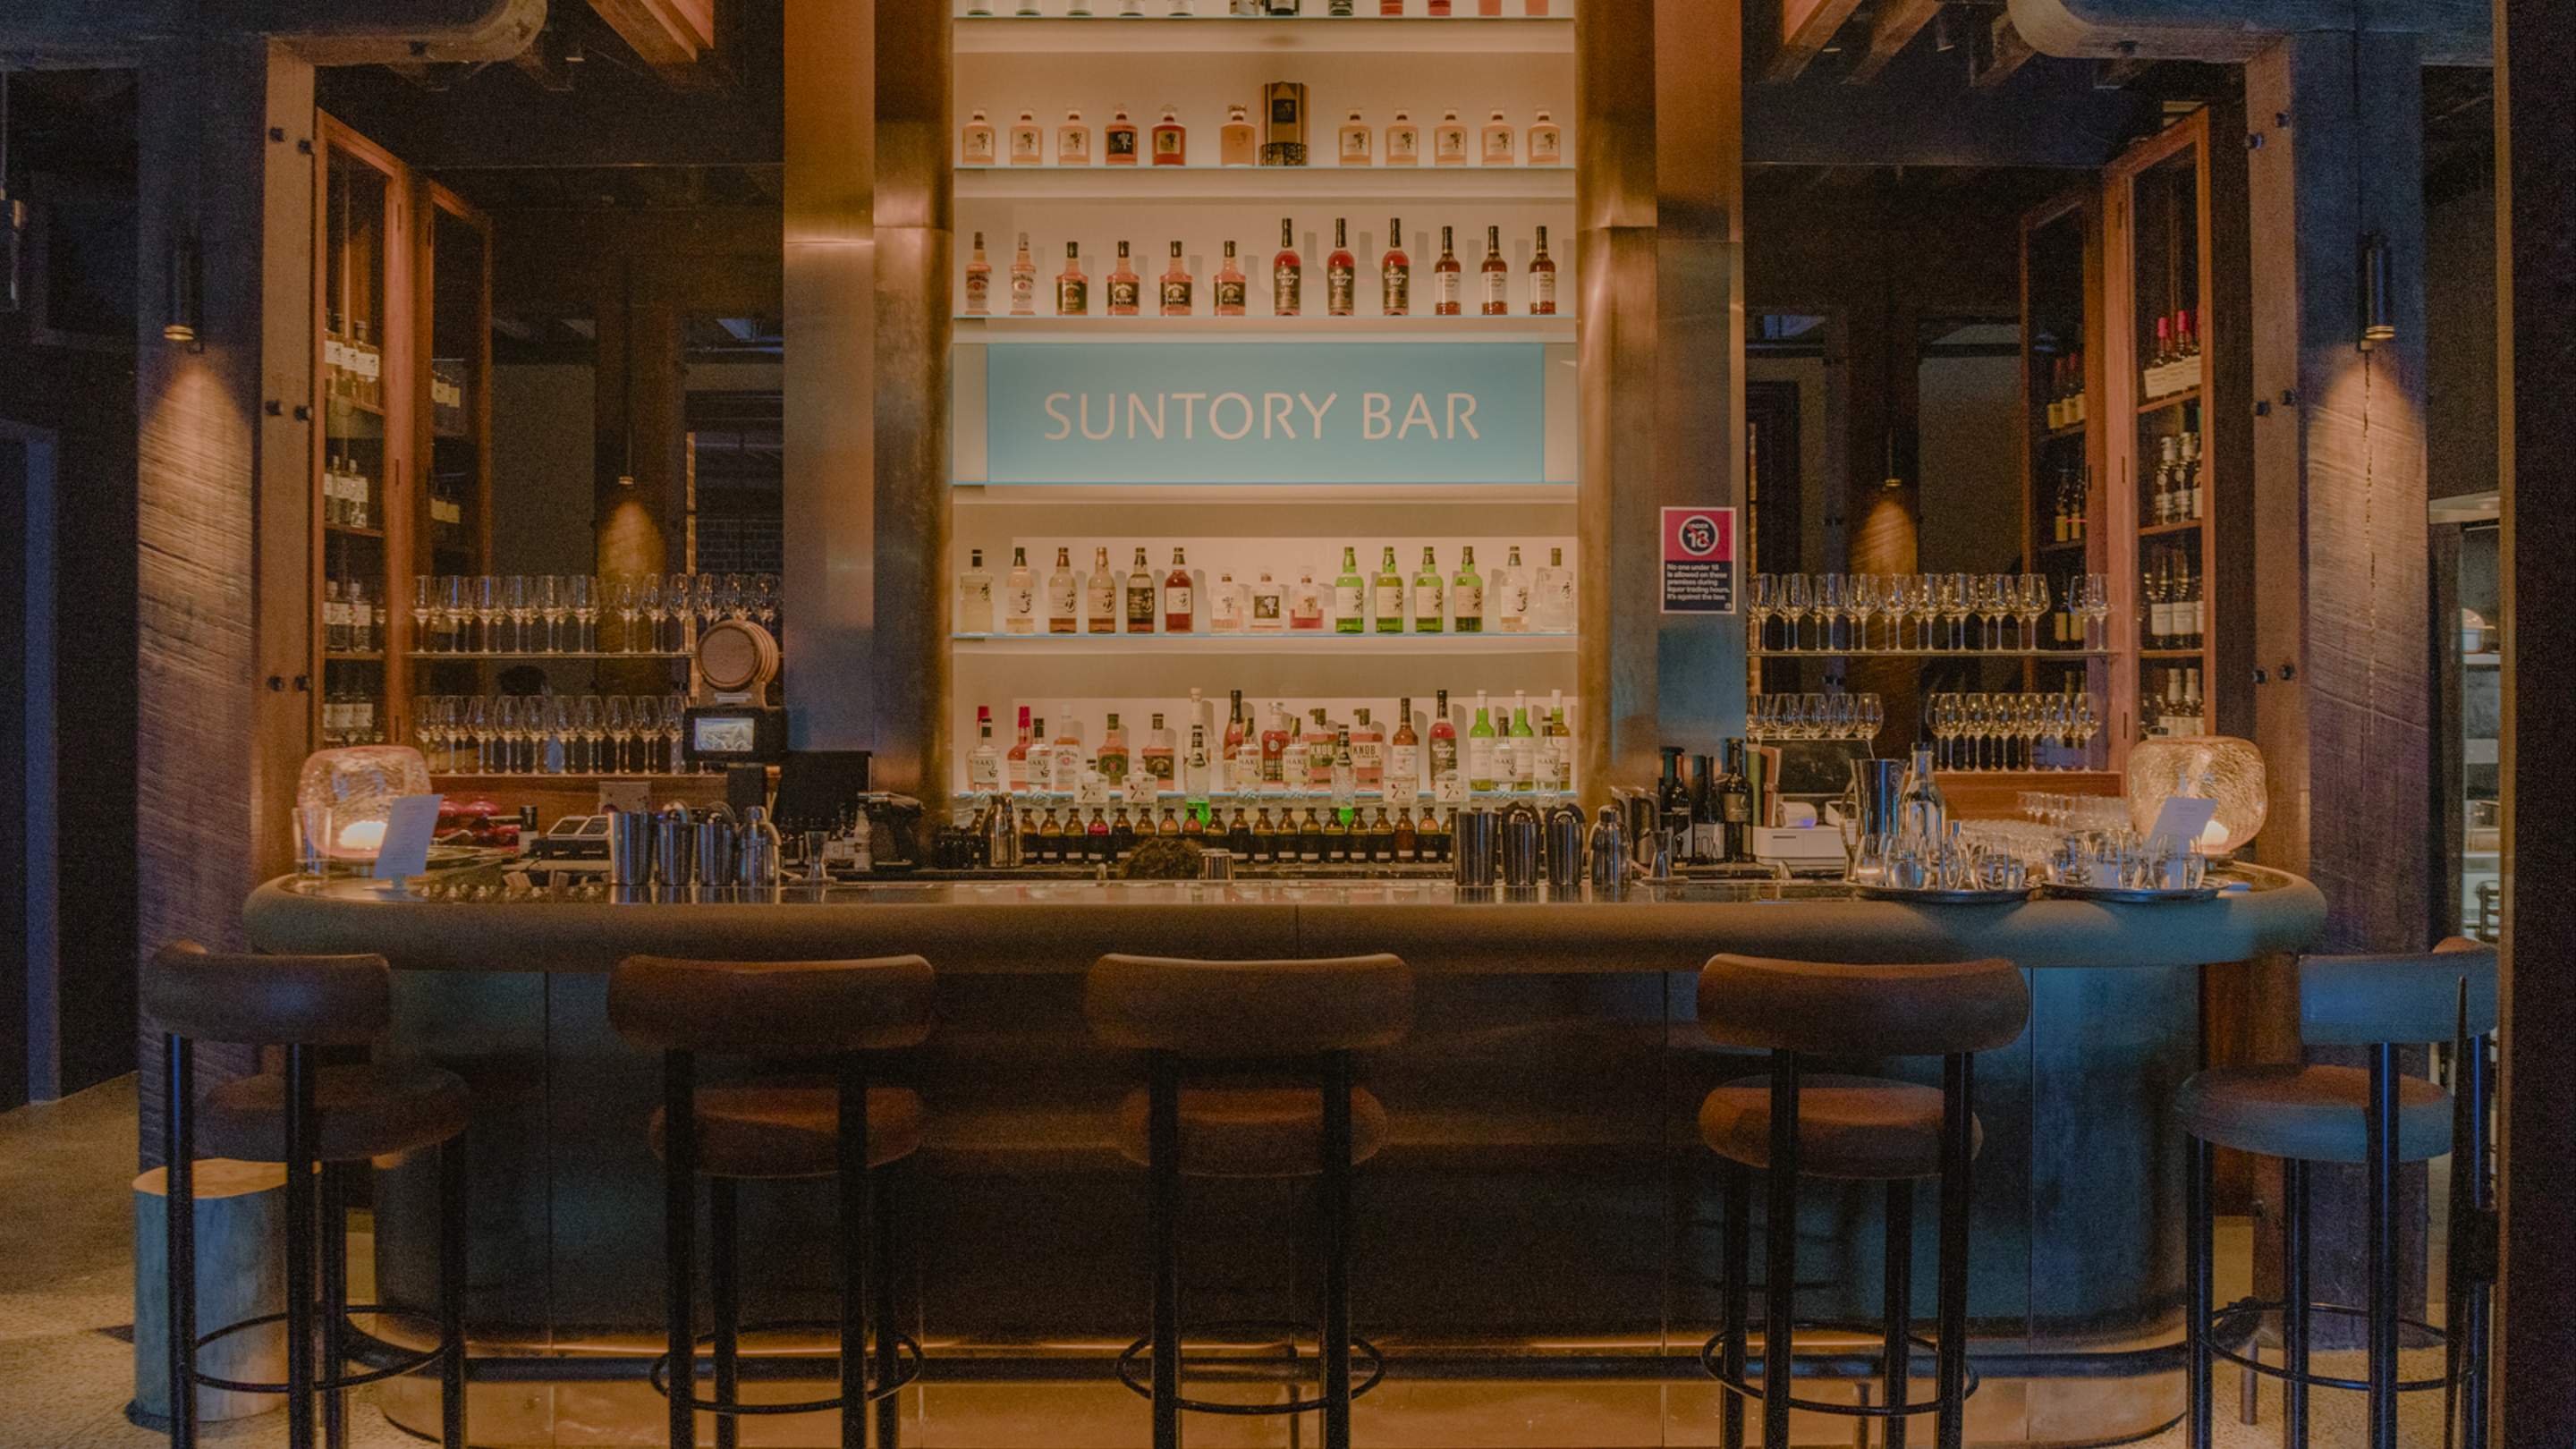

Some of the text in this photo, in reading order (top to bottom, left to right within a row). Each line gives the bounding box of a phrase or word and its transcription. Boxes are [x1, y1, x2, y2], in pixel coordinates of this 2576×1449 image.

[1044, 391, 1480, 441] SUNTORY BAR
[1309, 744, 1333, 755] KNOB
[1353, 744, 1376, 755] KNOB
